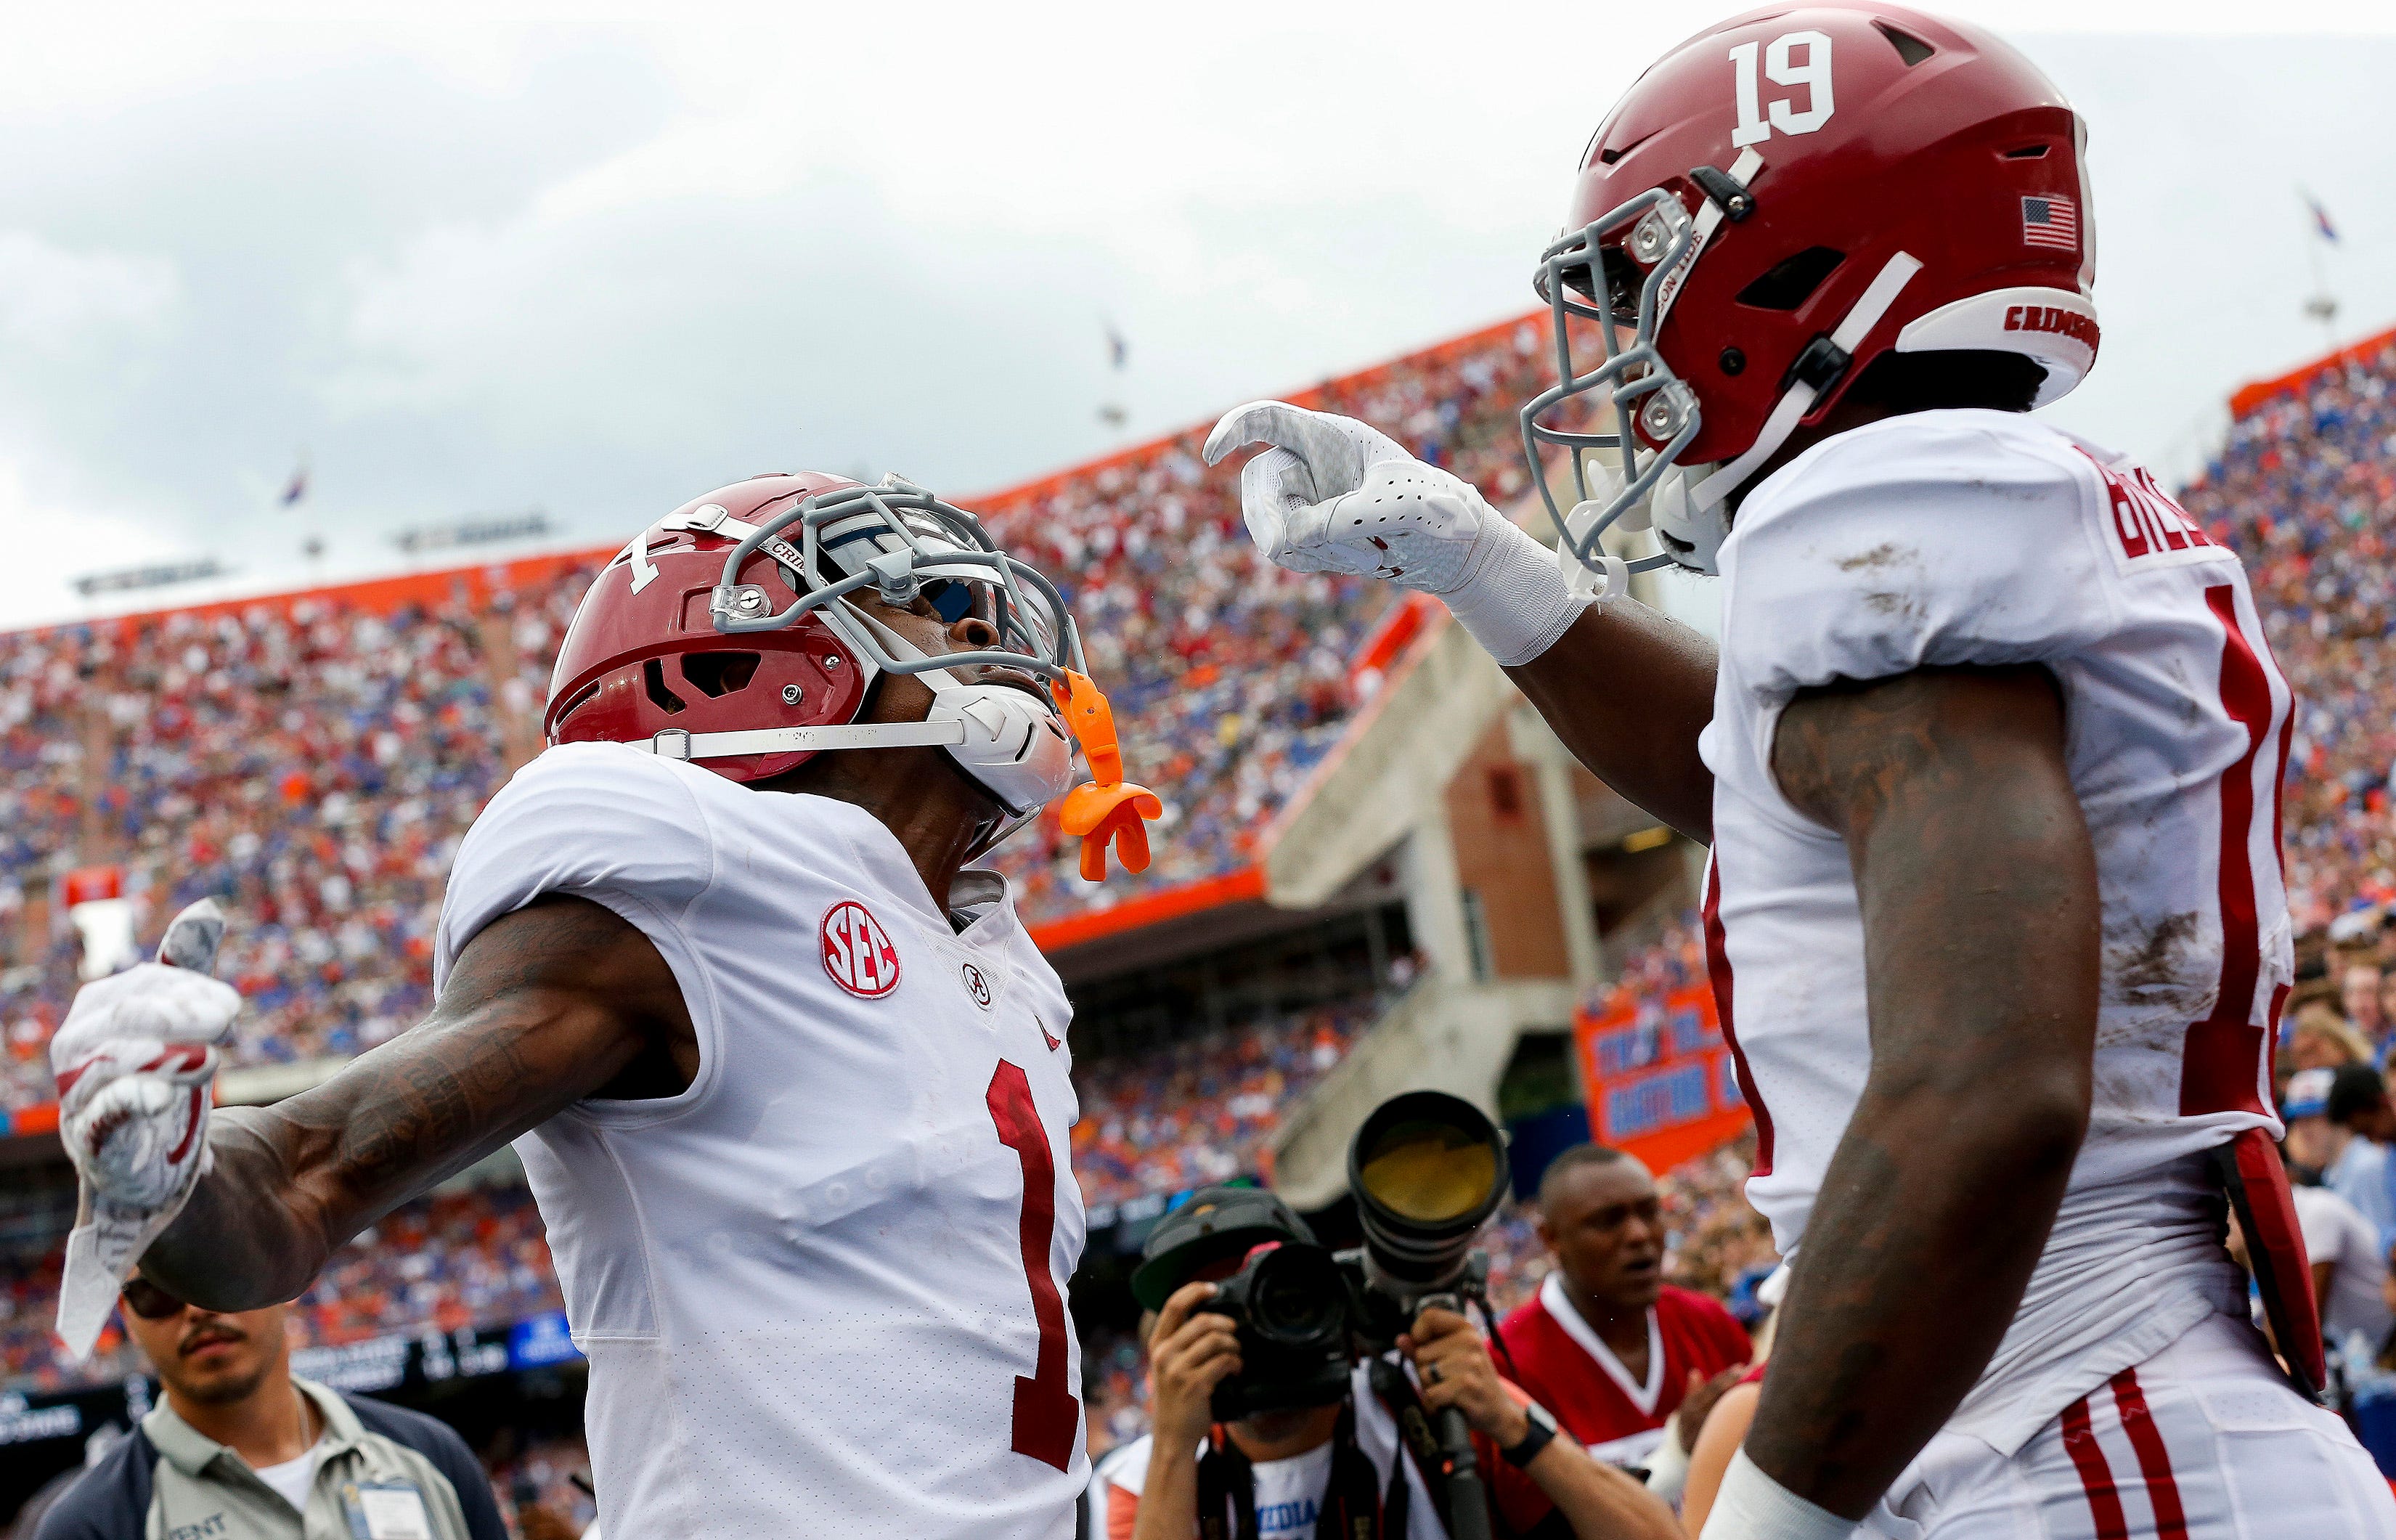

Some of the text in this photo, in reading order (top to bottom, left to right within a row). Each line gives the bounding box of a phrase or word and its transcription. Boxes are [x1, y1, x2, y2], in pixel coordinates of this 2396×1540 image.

[1727, 30, 1835, 149] 19
[823, 904, 897, 991] SEC
[985, 1057, 1079, 1474] 1
[1255, 1498, 1319, 1532] EDIA
